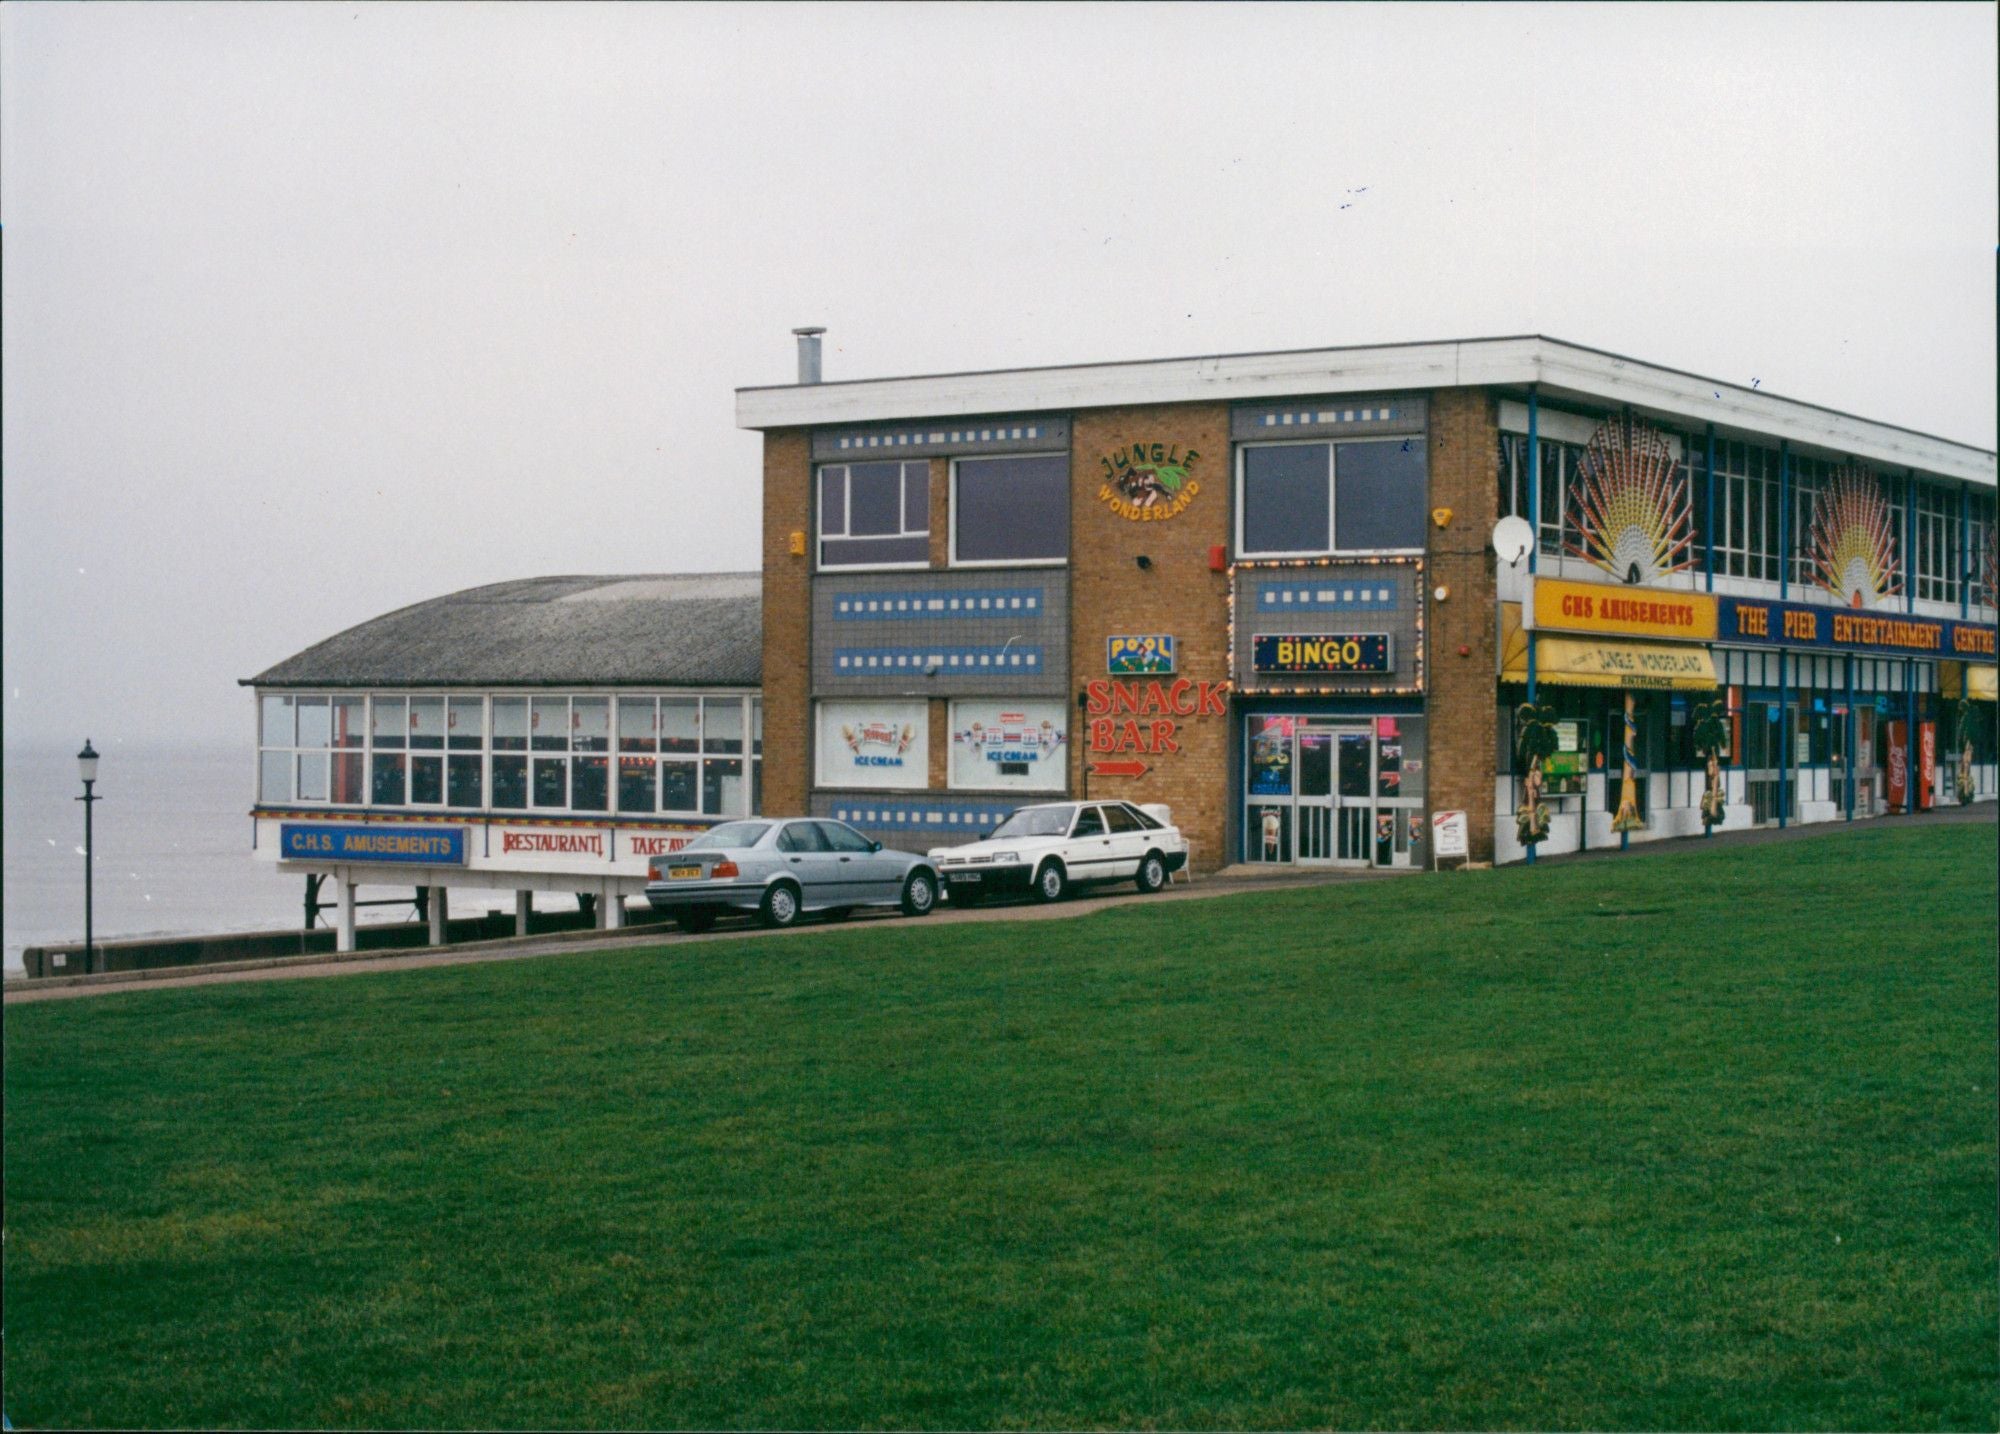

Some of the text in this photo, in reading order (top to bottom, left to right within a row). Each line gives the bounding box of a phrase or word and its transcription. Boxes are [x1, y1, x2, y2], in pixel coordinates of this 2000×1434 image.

[1101, 442, 1200, 480] JUNGLE
[1099, 481, 1199, 521] WONDERLAND
[1562, 595, 1694, 626] CHS AMUSEMENTS
[1736, 604, 1995, 655] THE PIER ENTERTAINMENT CENTRE
[1111, 638, 1171, 658] POOL
[1277, 641, 1361, 664] BINGO
[1621, 675, 1673, 688] ENTRANCE
[1087, 678, 1227, 716] SNACK
[1089, 717, 1179, 753] BAR
[986, 751, 1038, 761] ICE CREAM
[344, 835, 451, 854] AMUSEMENTS
[505, 833, 598, 853] RESTAURANT
